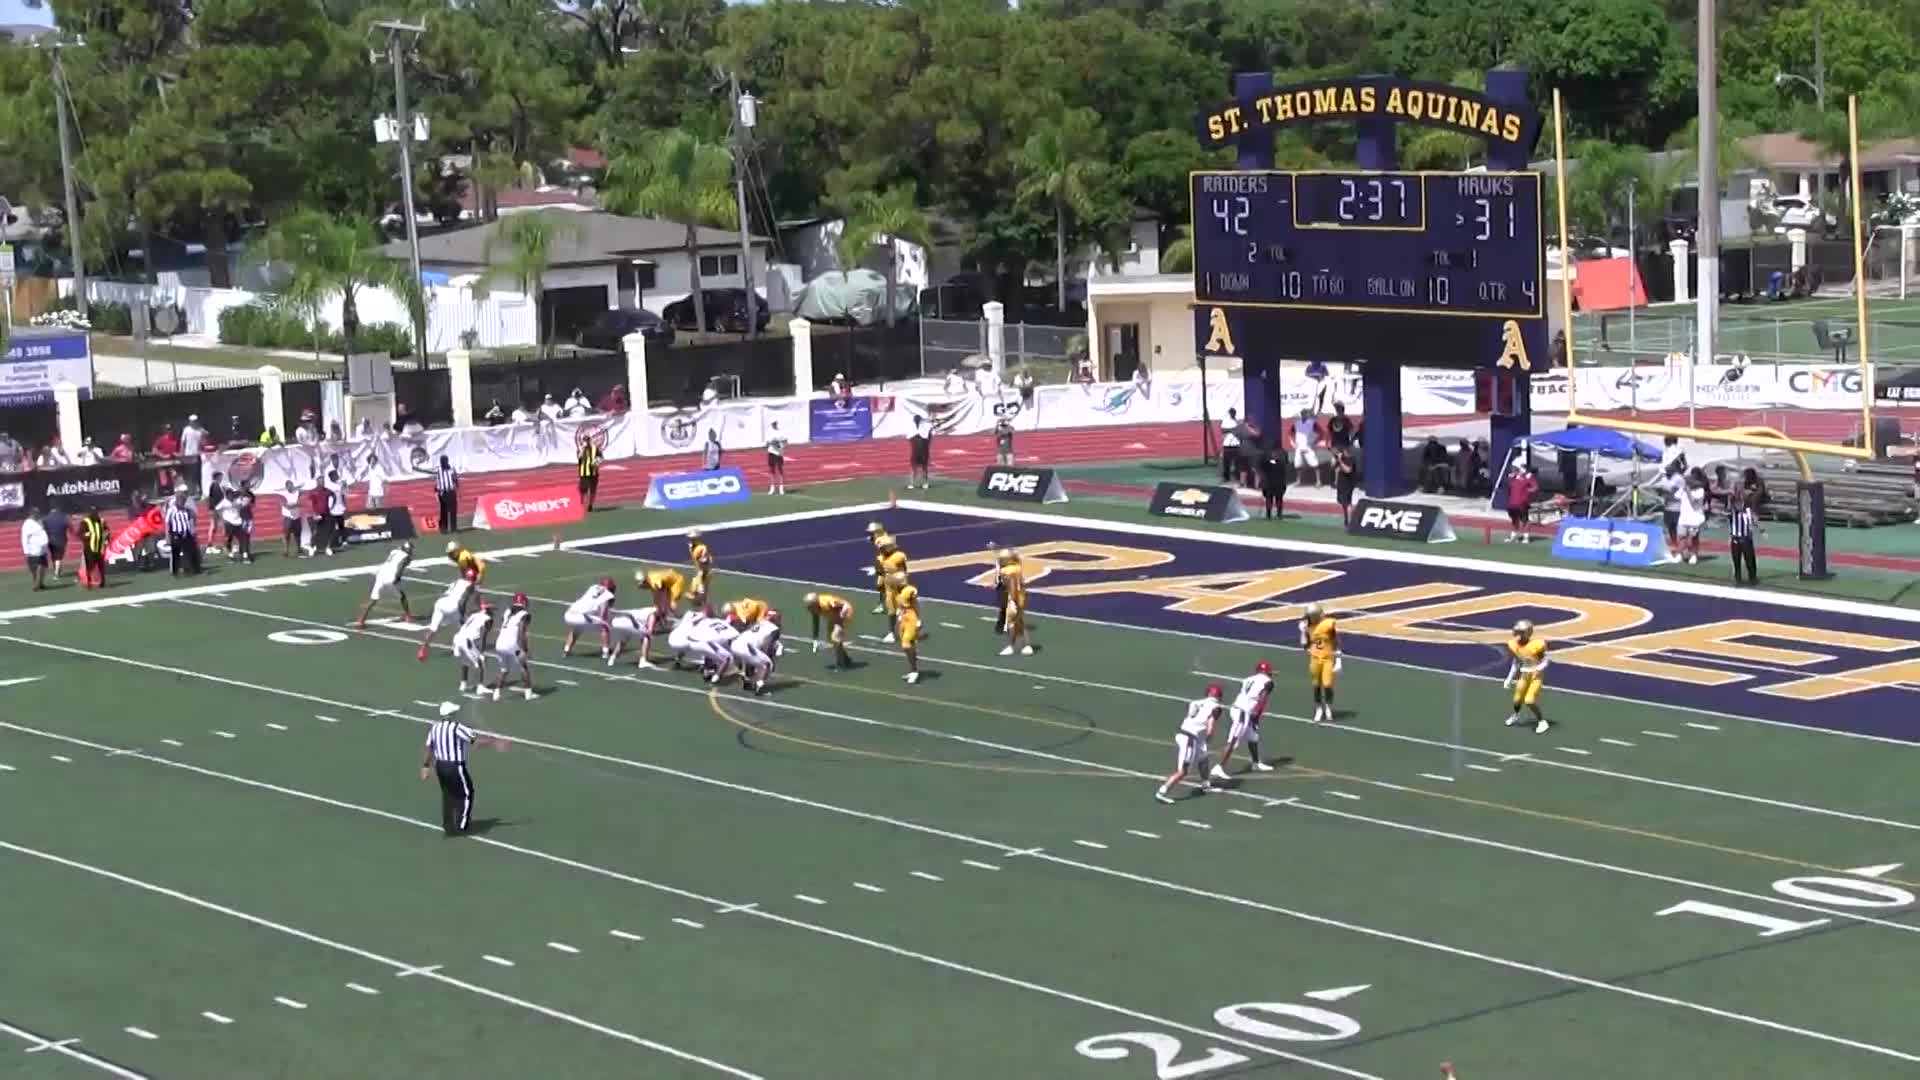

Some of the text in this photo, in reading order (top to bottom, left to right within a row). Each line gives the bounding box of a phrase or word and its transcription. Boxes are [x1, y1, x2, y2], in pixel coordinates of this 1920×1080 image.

[1207, 87, 1521, 142] ST. THOMAS AQUINAS
[1203, 176, 1267, 193] RAIDERS
[1458, 177, 1514, 196] HAWKS
[1339, 180, 1405, 220] 2:37
[1213, 197, 1249, 235] 42
[1475, 199, 1515, 241] 31
[1248, 242, 1257, 263] 2
[1282, 271, 1301, 299] 10
[1429, 276, 1449, 304] 10
[1522, 280, 1536, 306] 4
[1205, 306, 1235, 354] A
[1496, 319, 1531, 370] A
[1788, 370, 1863, 393] CMG
[46, 479, 121, 496] AutoNation
[663, 475, 742, 500] GEICO
[988, 472, 1040, 494] AXE
[1361, 507, 1422, 532] AXE
[1562, 527, 1649, 553] GEICO
[1655, 875, 1915, 937] 10
[1075, 1001, 1362, 1080] 20
